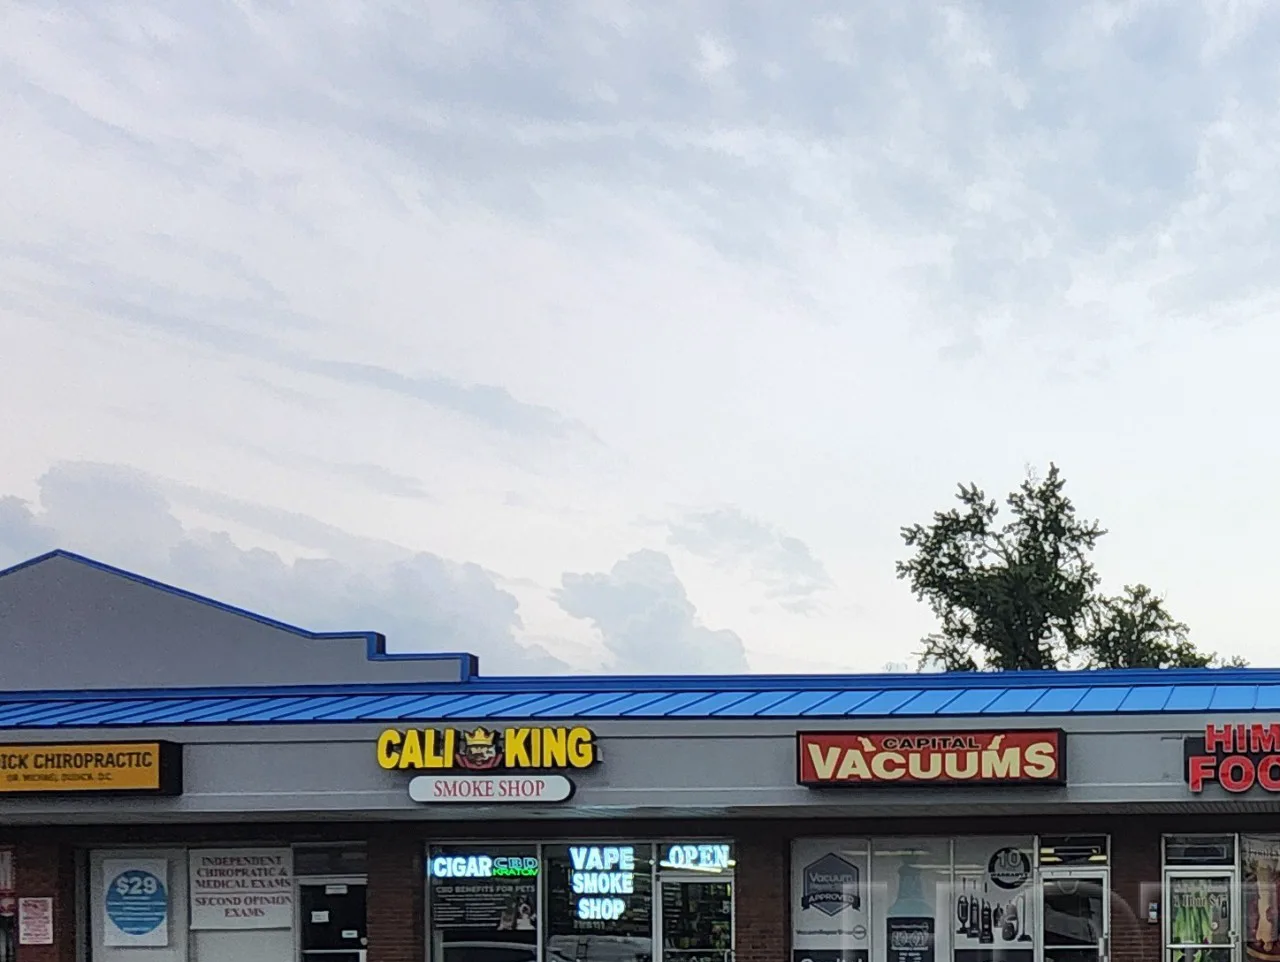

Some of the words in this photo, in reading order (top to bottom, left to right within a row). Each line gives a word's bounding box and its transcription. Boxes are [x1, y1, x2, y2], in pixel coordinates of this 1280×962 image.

[377, 728, 455, 769] CALI
[505, 726, 593, 768] KING
[883, 737, 980, 749] CAPITAL
[33, 752, 152, 768] CHIROPRACTIC
[808, 742, 1056, 779] VACUUMS
[434, 780, 494, 797] SMOKE
[498, 780, 545, 797] SHOP
[202, 856, 282, 866] INDEPENDENT
[493, 857, 538, 869] CBD
[569, 846, 635, 870] VAPE
[669, 844, 730, 868] OPEN
[998, 849, 1020, 867] 10
[433, 855, 493, 877] CIGAR
[116, 875, 158, 896] $29
[571, 872, 634, 894] SMOKE
[808, 871, 853, 882] Vacuum
[808, 893, 854, 903] APPROVED
[225, 908, 265, 917] EXAMS
[578, 897, 626, 920] SHOP
